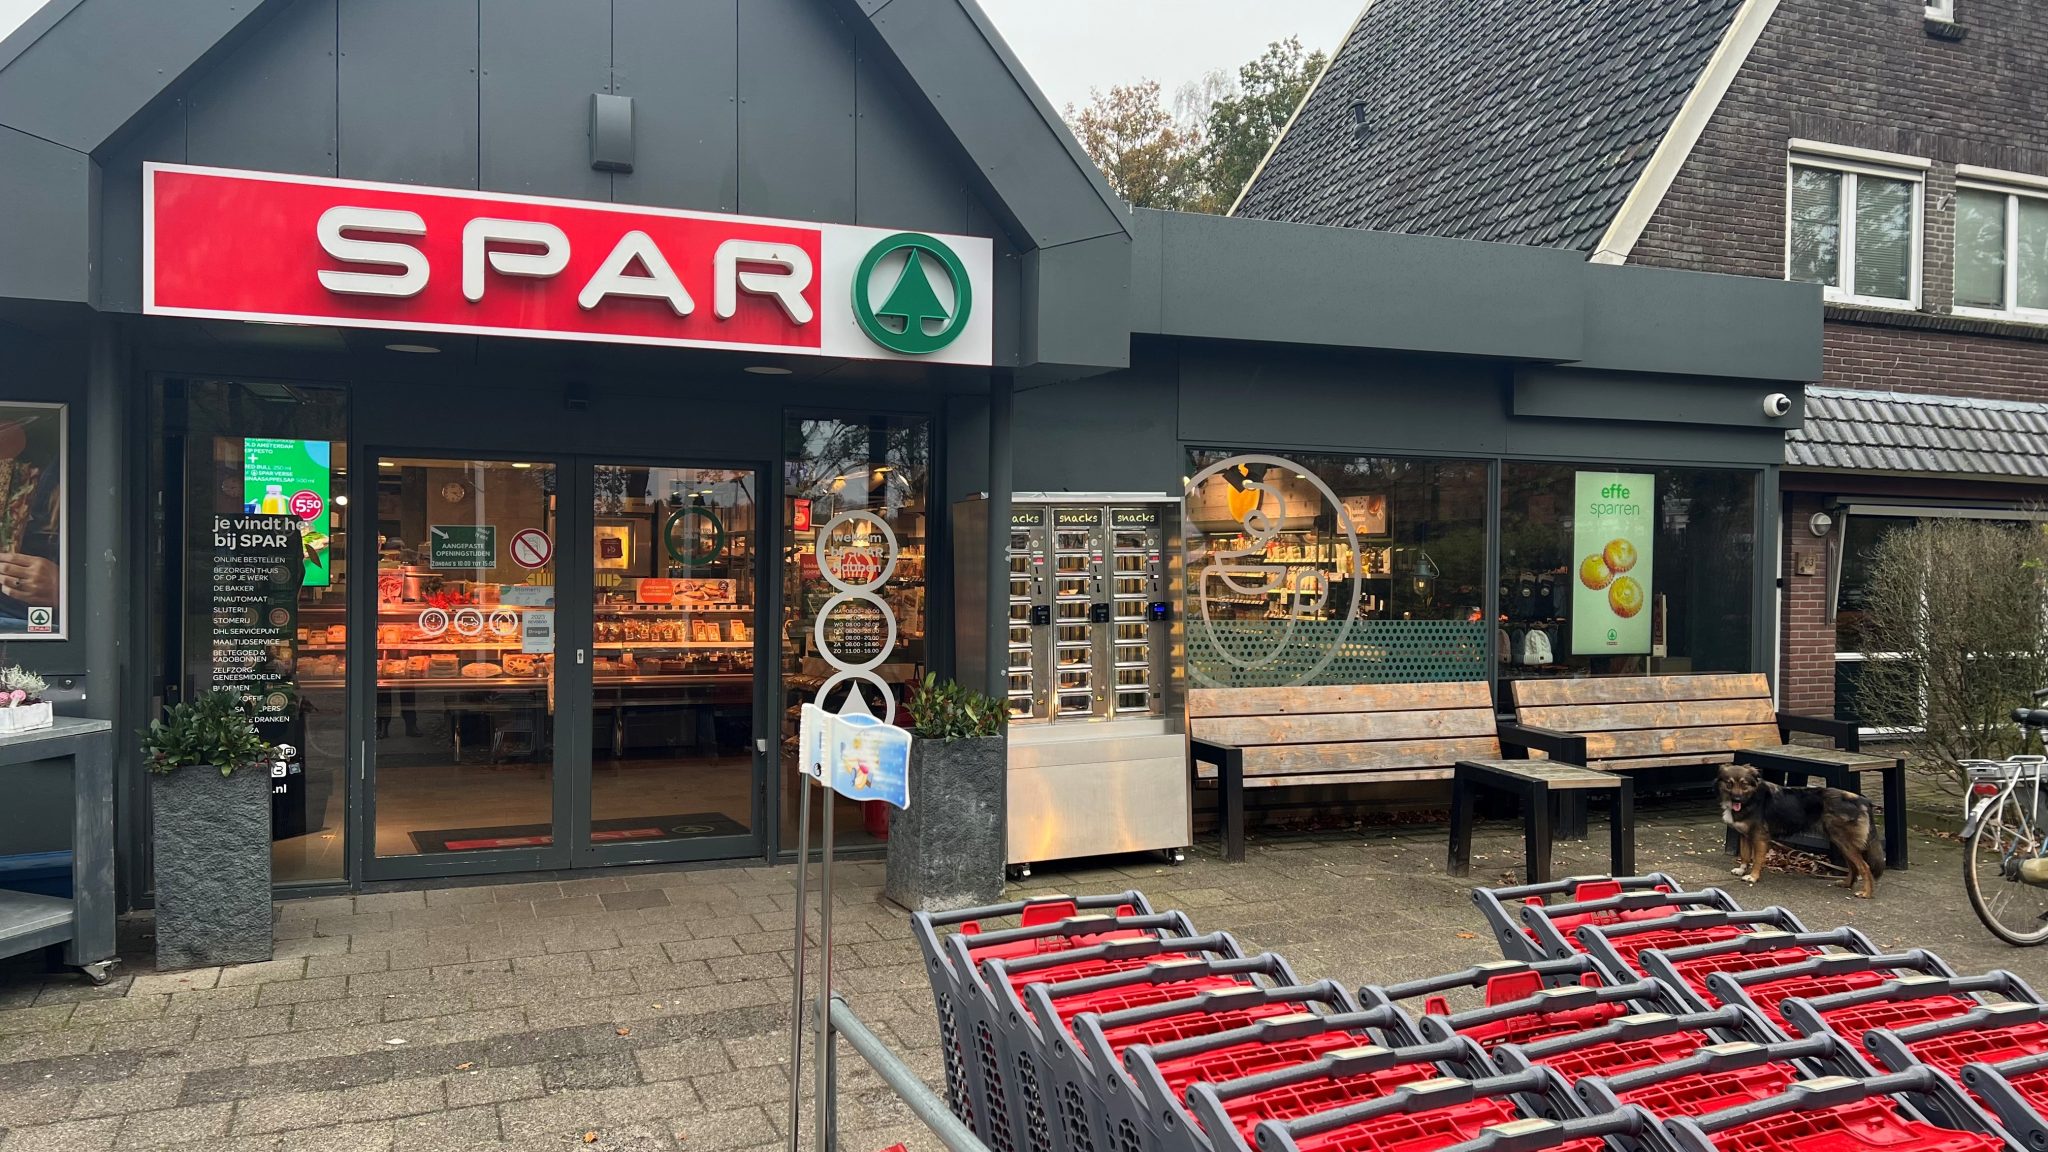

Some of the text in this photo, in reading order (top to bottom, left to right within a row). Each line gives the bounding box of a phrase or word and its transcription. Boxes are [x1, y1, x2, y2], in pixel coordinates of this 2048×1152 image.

[316, 205, 813, 325] SPAR
[1601, 484, 1630, 499] effe
[1590, 501, 1640, 518] sparren
[1011, 513, 1040, 523] acks
[1059, 513, 1098, 523] snacks
[1117, 512, 1155, 522] snacks
[212, 515, 309, 532] je vindt he
[214, 533, 287, 550] bij SPAR
[243, 556, 286, 564] BESTELLEN
[213, 638, 280, 646] MAALTIJDSERVICE
[212, 666, 256, 674] ZELFZORG-
[212, 673, 281, 681] GENEESMIDDELEN
[254, 715, 290, 723] DRANKEN
